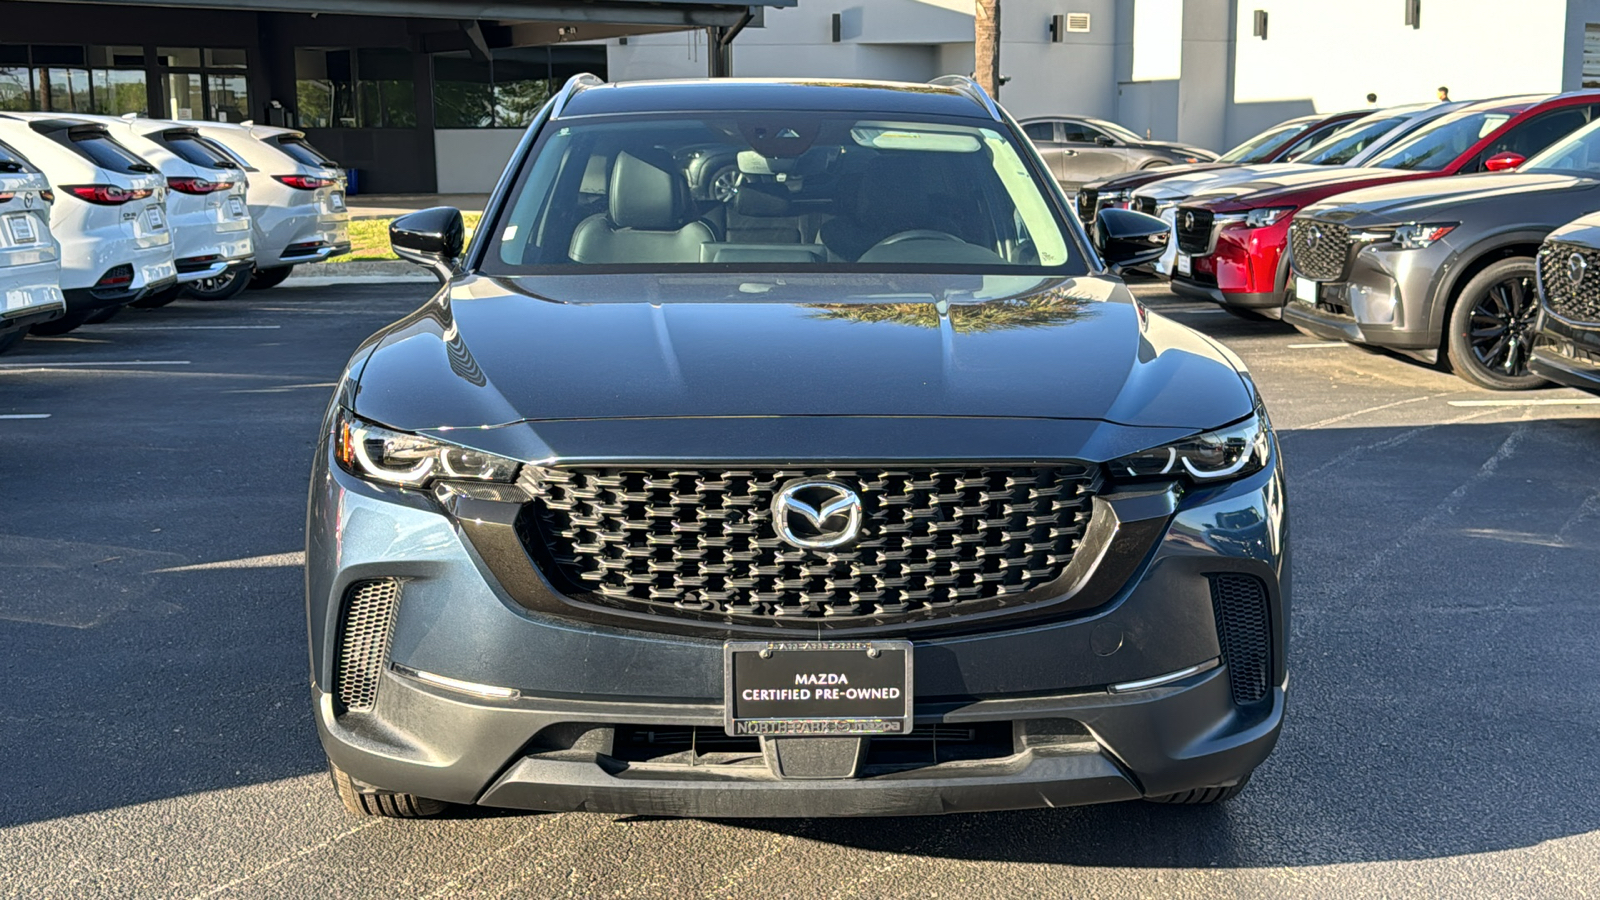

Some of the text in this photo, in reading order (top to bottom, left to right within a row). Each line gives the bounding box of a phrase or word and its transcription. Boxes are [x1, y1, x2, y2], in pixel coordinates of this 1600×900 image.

[794, 673, 848, 685] MAZDA
[742, 687, 900, 700] CERTIFIED PRE-OWNED
